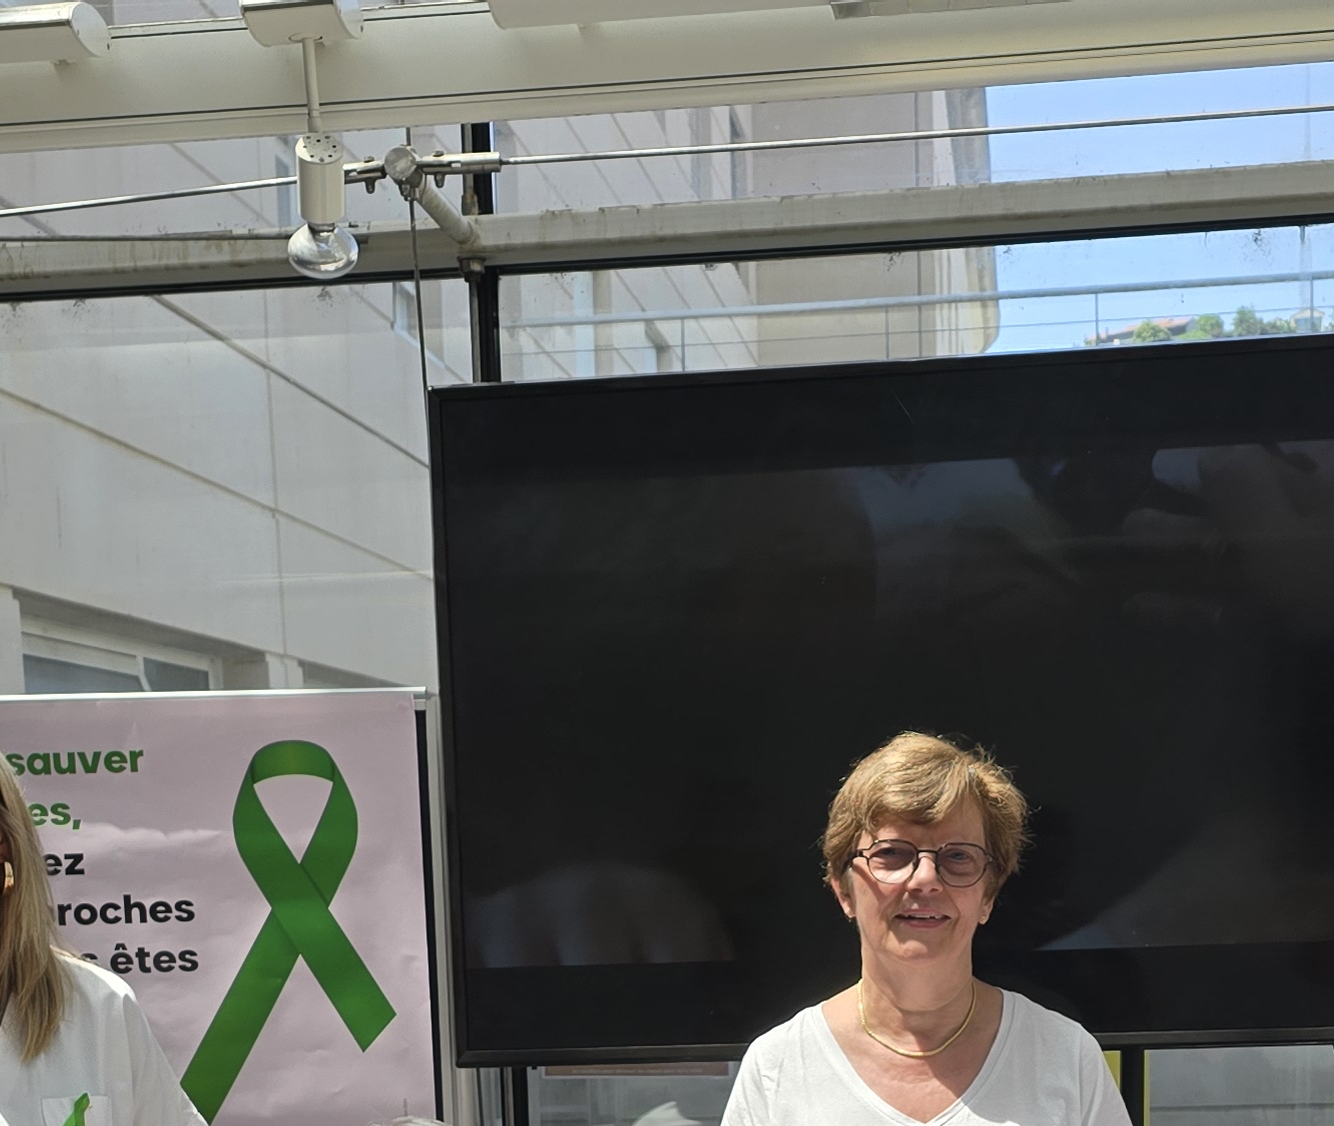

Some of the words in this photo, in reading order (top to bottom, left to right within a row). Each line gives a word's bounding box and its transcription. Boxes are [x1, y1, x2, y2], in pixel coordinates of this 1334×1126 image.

[5, 749, 145, 776] sauver
[57, 893, 196, 927] roches
[109, 942, 199, 975] êtes
